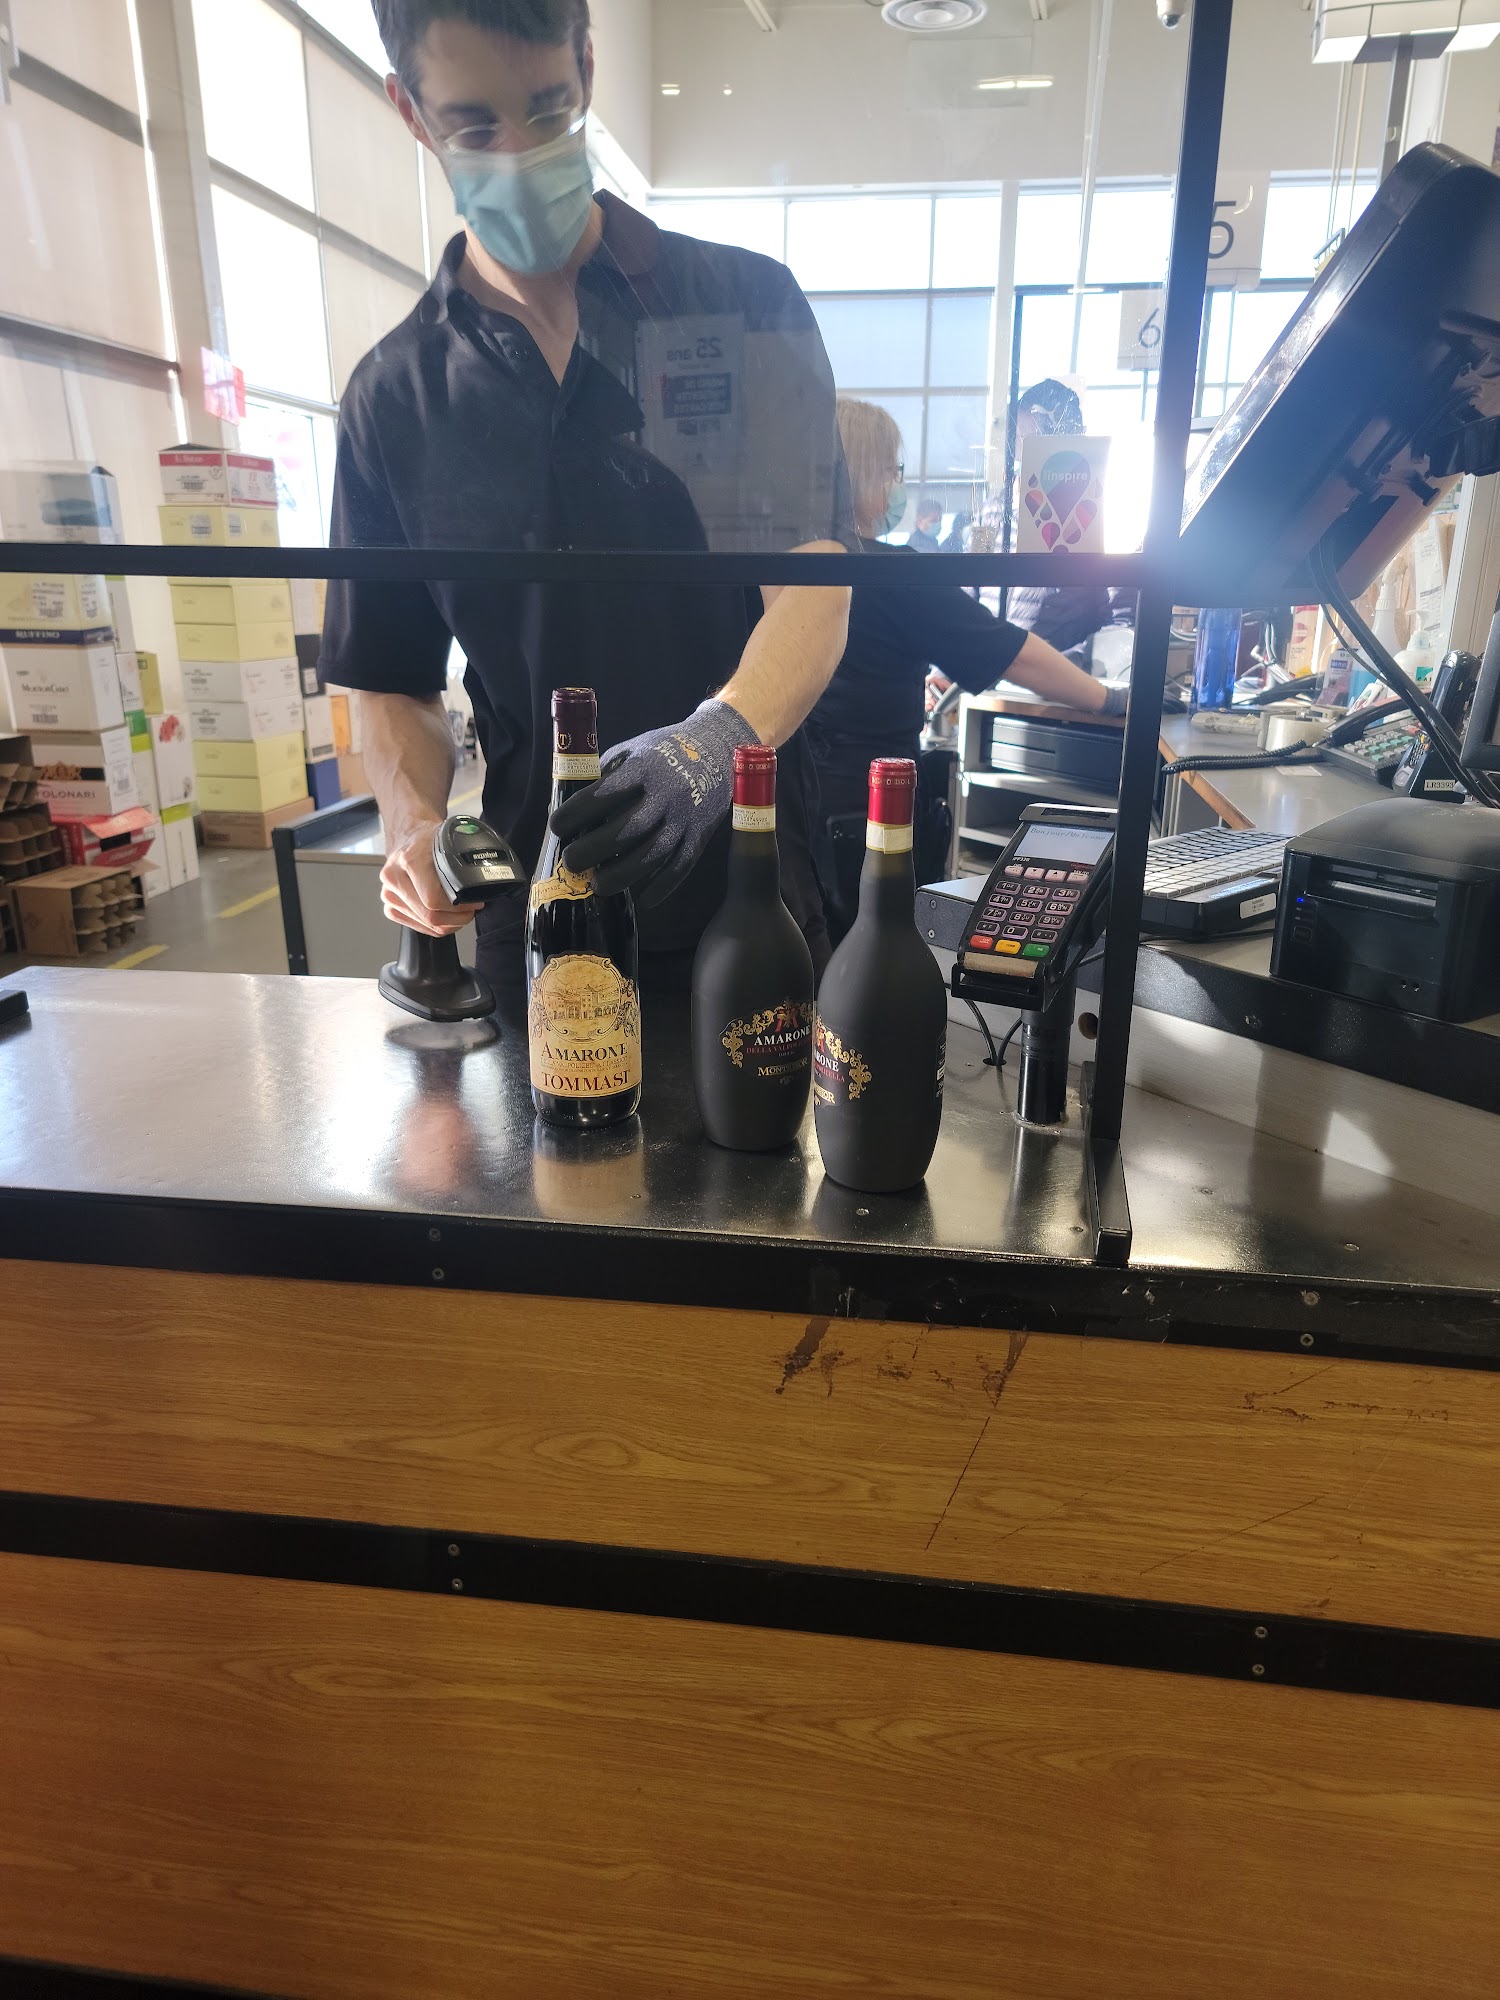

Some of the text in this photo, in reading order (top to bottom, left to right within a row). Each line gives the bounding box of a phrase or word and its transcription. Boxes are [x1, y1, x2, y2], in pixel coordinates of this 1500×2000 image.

[1208, 200, 1236, 259] 5
[1138, 307, 1161, 348] 6
[559, 733, 568, 746] T
[37, 790, 96, 799] OLONARI
[1425, 781, 1454, 789] LR3393
[754, 1024, 811, 1047] AMARONE
[541, 1041, 628, 1062] AMARONE
[541, 1069, 631, 1092] TOMMASI
